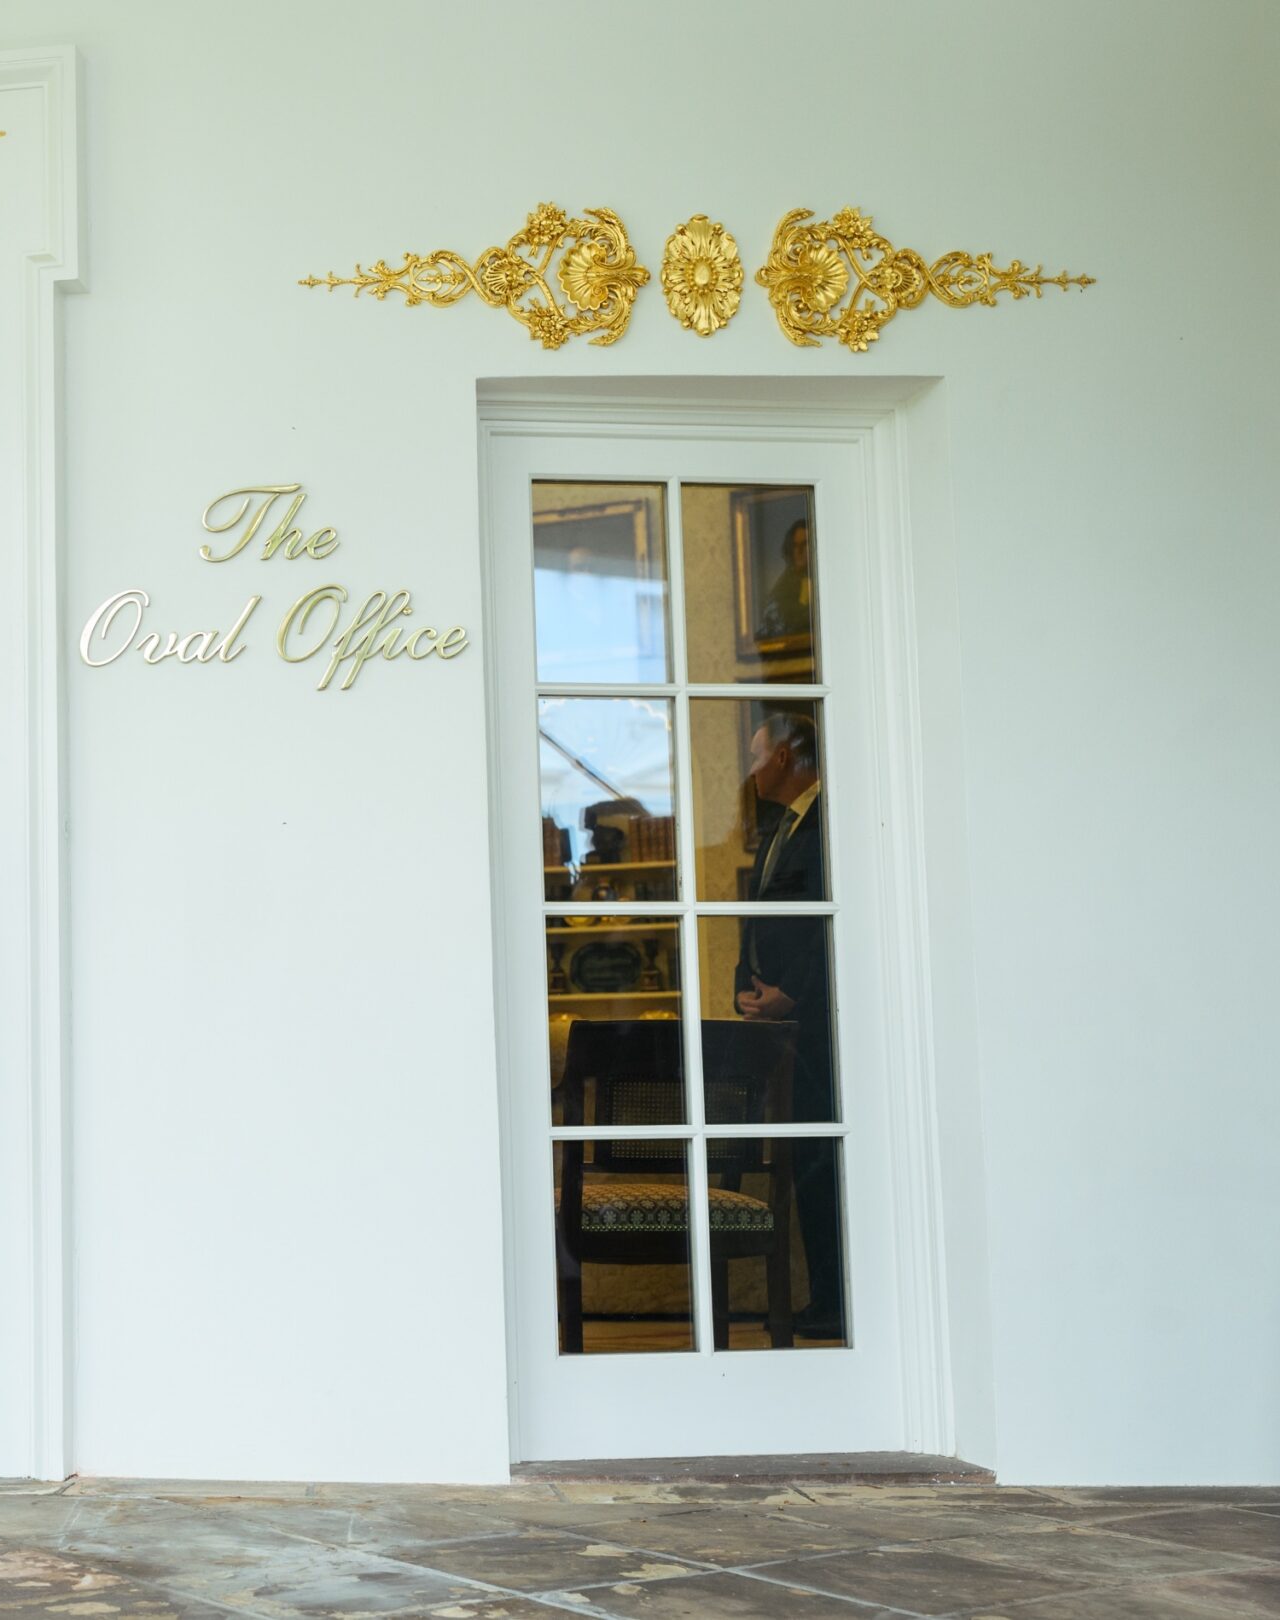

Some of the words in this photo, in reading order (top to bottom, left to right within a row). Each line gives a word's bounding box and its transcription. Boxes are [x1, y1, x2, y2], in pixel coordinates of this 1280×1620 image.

[199, 483, 340, 562] The
[79, 588, 262, 667] Oval
[276, 583, 470, 691] Office
